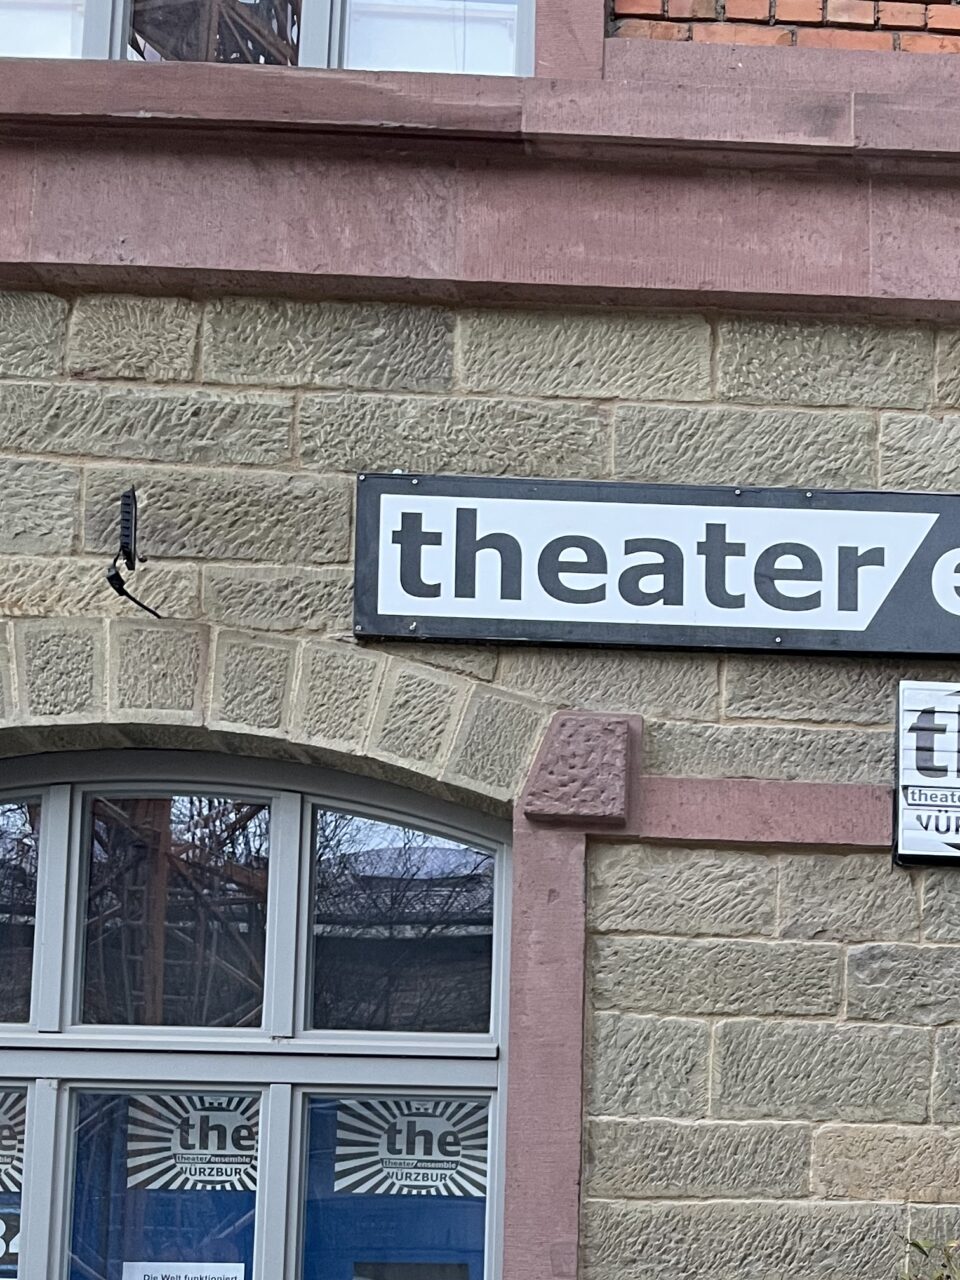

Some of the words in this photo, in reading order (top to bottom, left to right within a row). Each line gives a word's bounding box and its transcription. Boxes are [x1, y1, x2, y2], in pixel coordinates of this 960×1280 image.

[391, 507, 884, 612] theater
[176, 1115, 255, 1151] the
[384, 1121, 461, 1157] the
